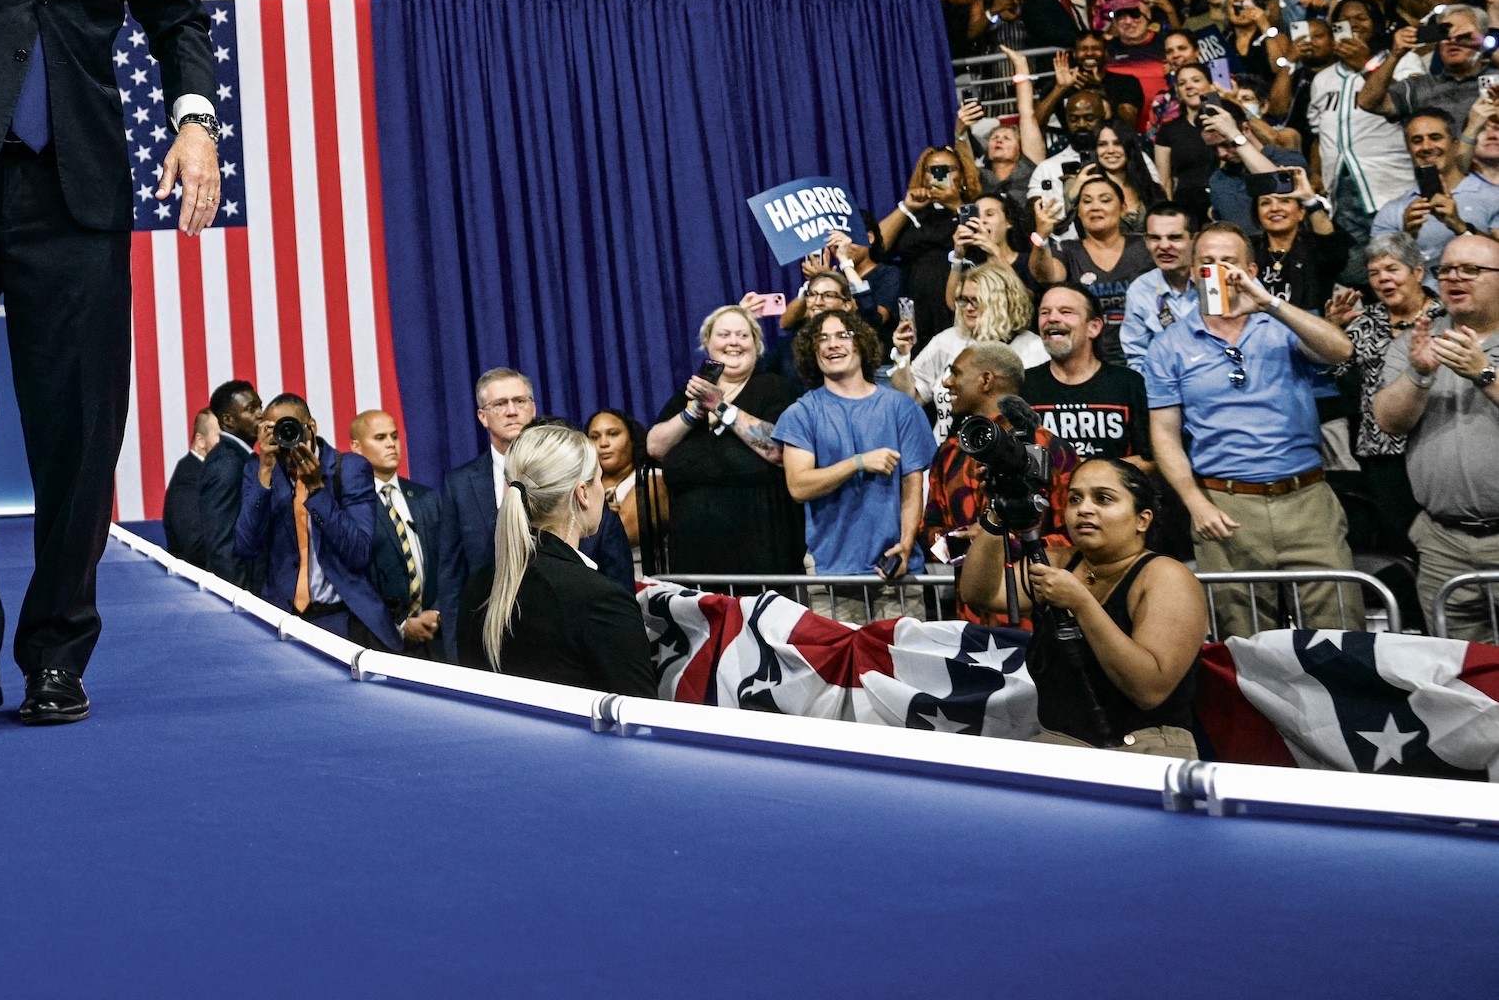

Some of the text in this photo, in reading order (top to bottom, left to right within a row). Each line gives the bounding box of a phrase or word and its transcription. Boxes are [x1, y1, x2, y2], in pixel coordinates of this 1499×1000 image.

[764, 186, 850, 232] HARRIS
[794, 215, 852, 242] WALZ
[1042, 411, 1124, 440] ARRIS
